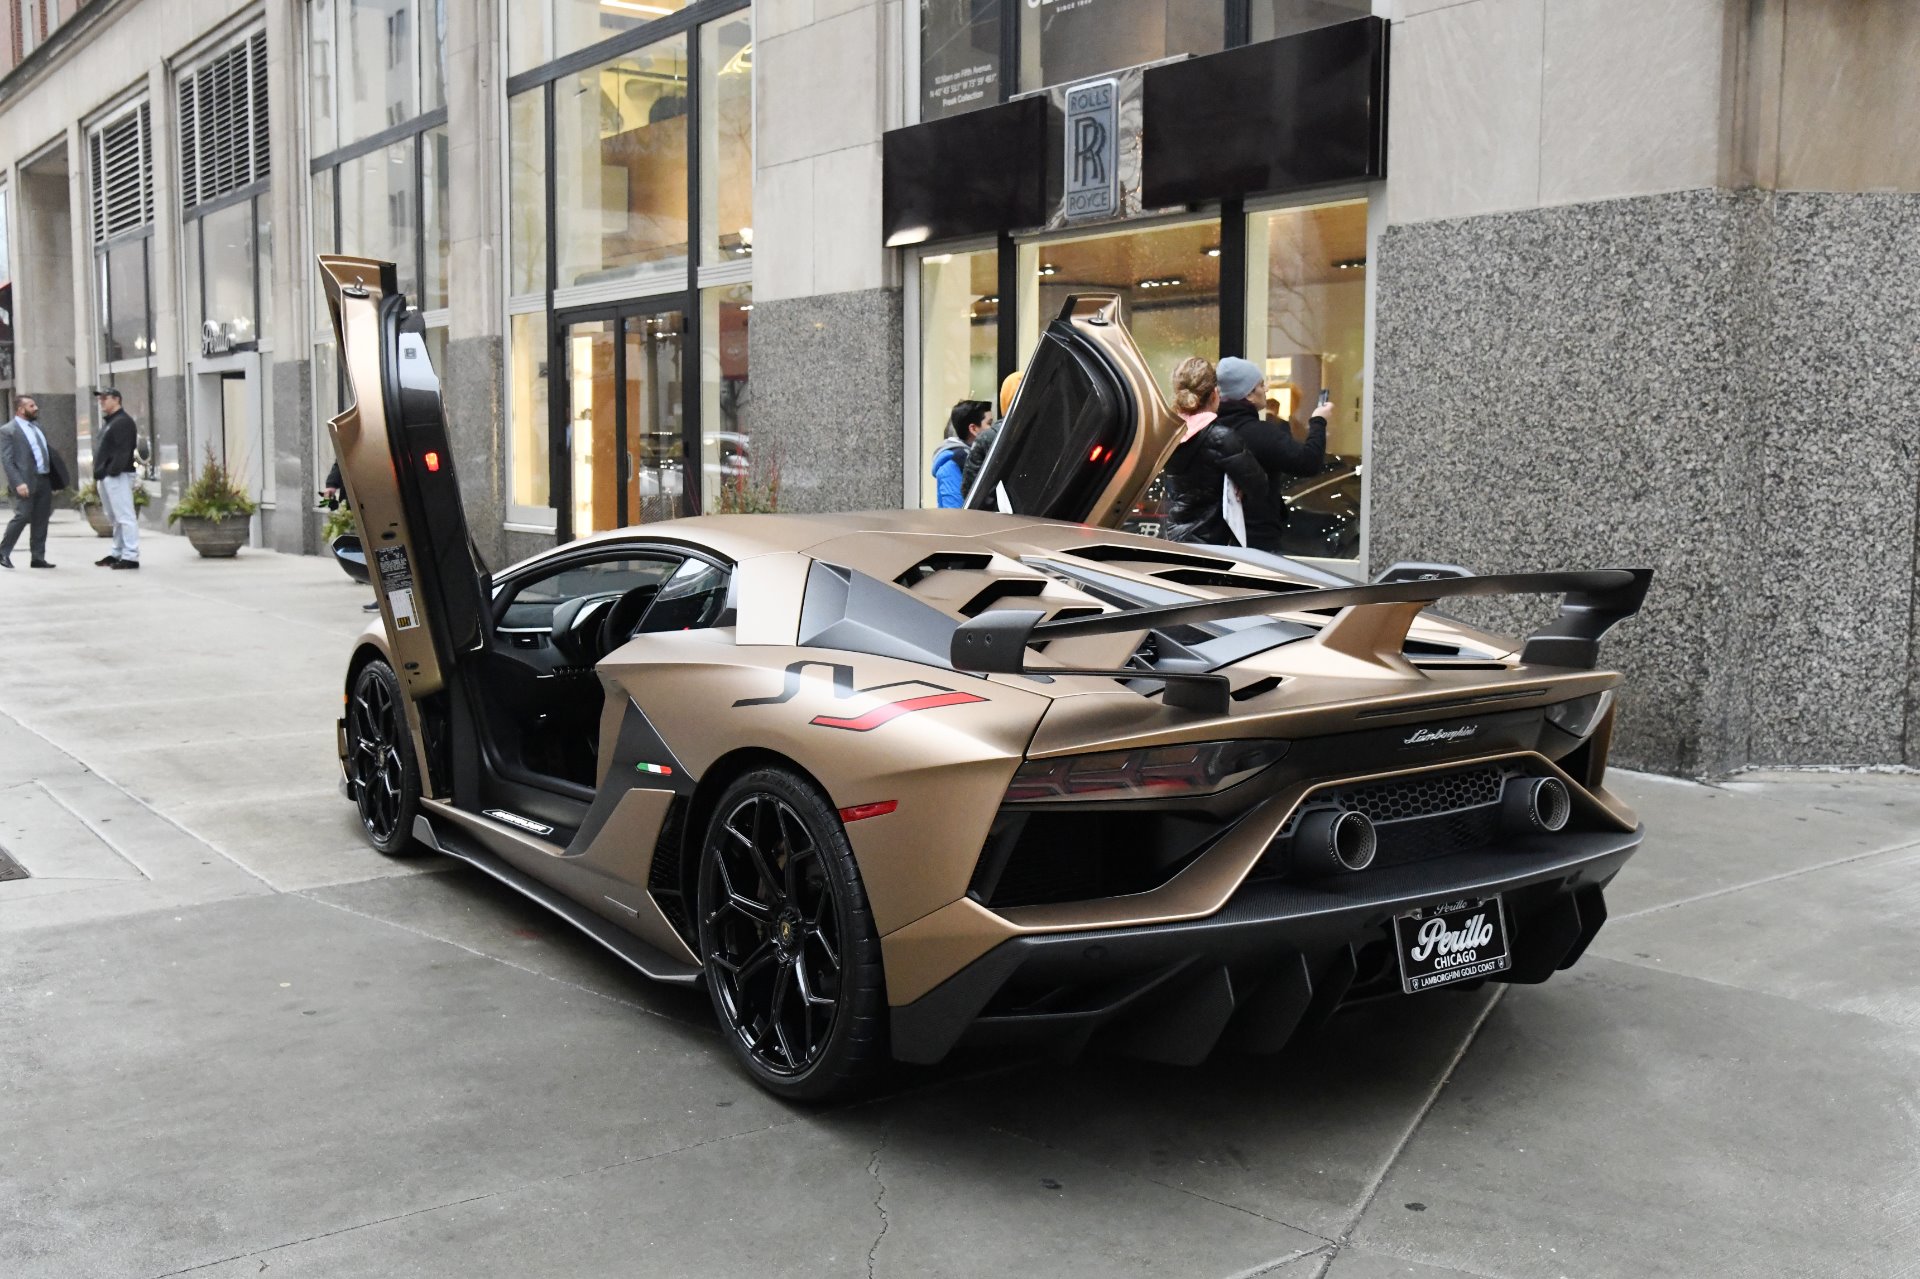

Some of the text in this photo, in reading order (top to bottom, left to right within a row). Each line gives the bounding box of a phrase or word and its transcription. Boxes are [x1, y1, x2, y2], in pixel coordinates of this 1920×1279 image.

[1070, 89, 1109, 111] ROLLS
[1069, 192, 1108, 211] ROYCE
[1403, 724, 1478, 744] Lamborghini
[1411, 913, 1494, 962] Perillo
[1434, 949, 1477, 970] CHICAGO
[1421, 961, 1495, 987] LAMBORGHINI GOLD COAST
